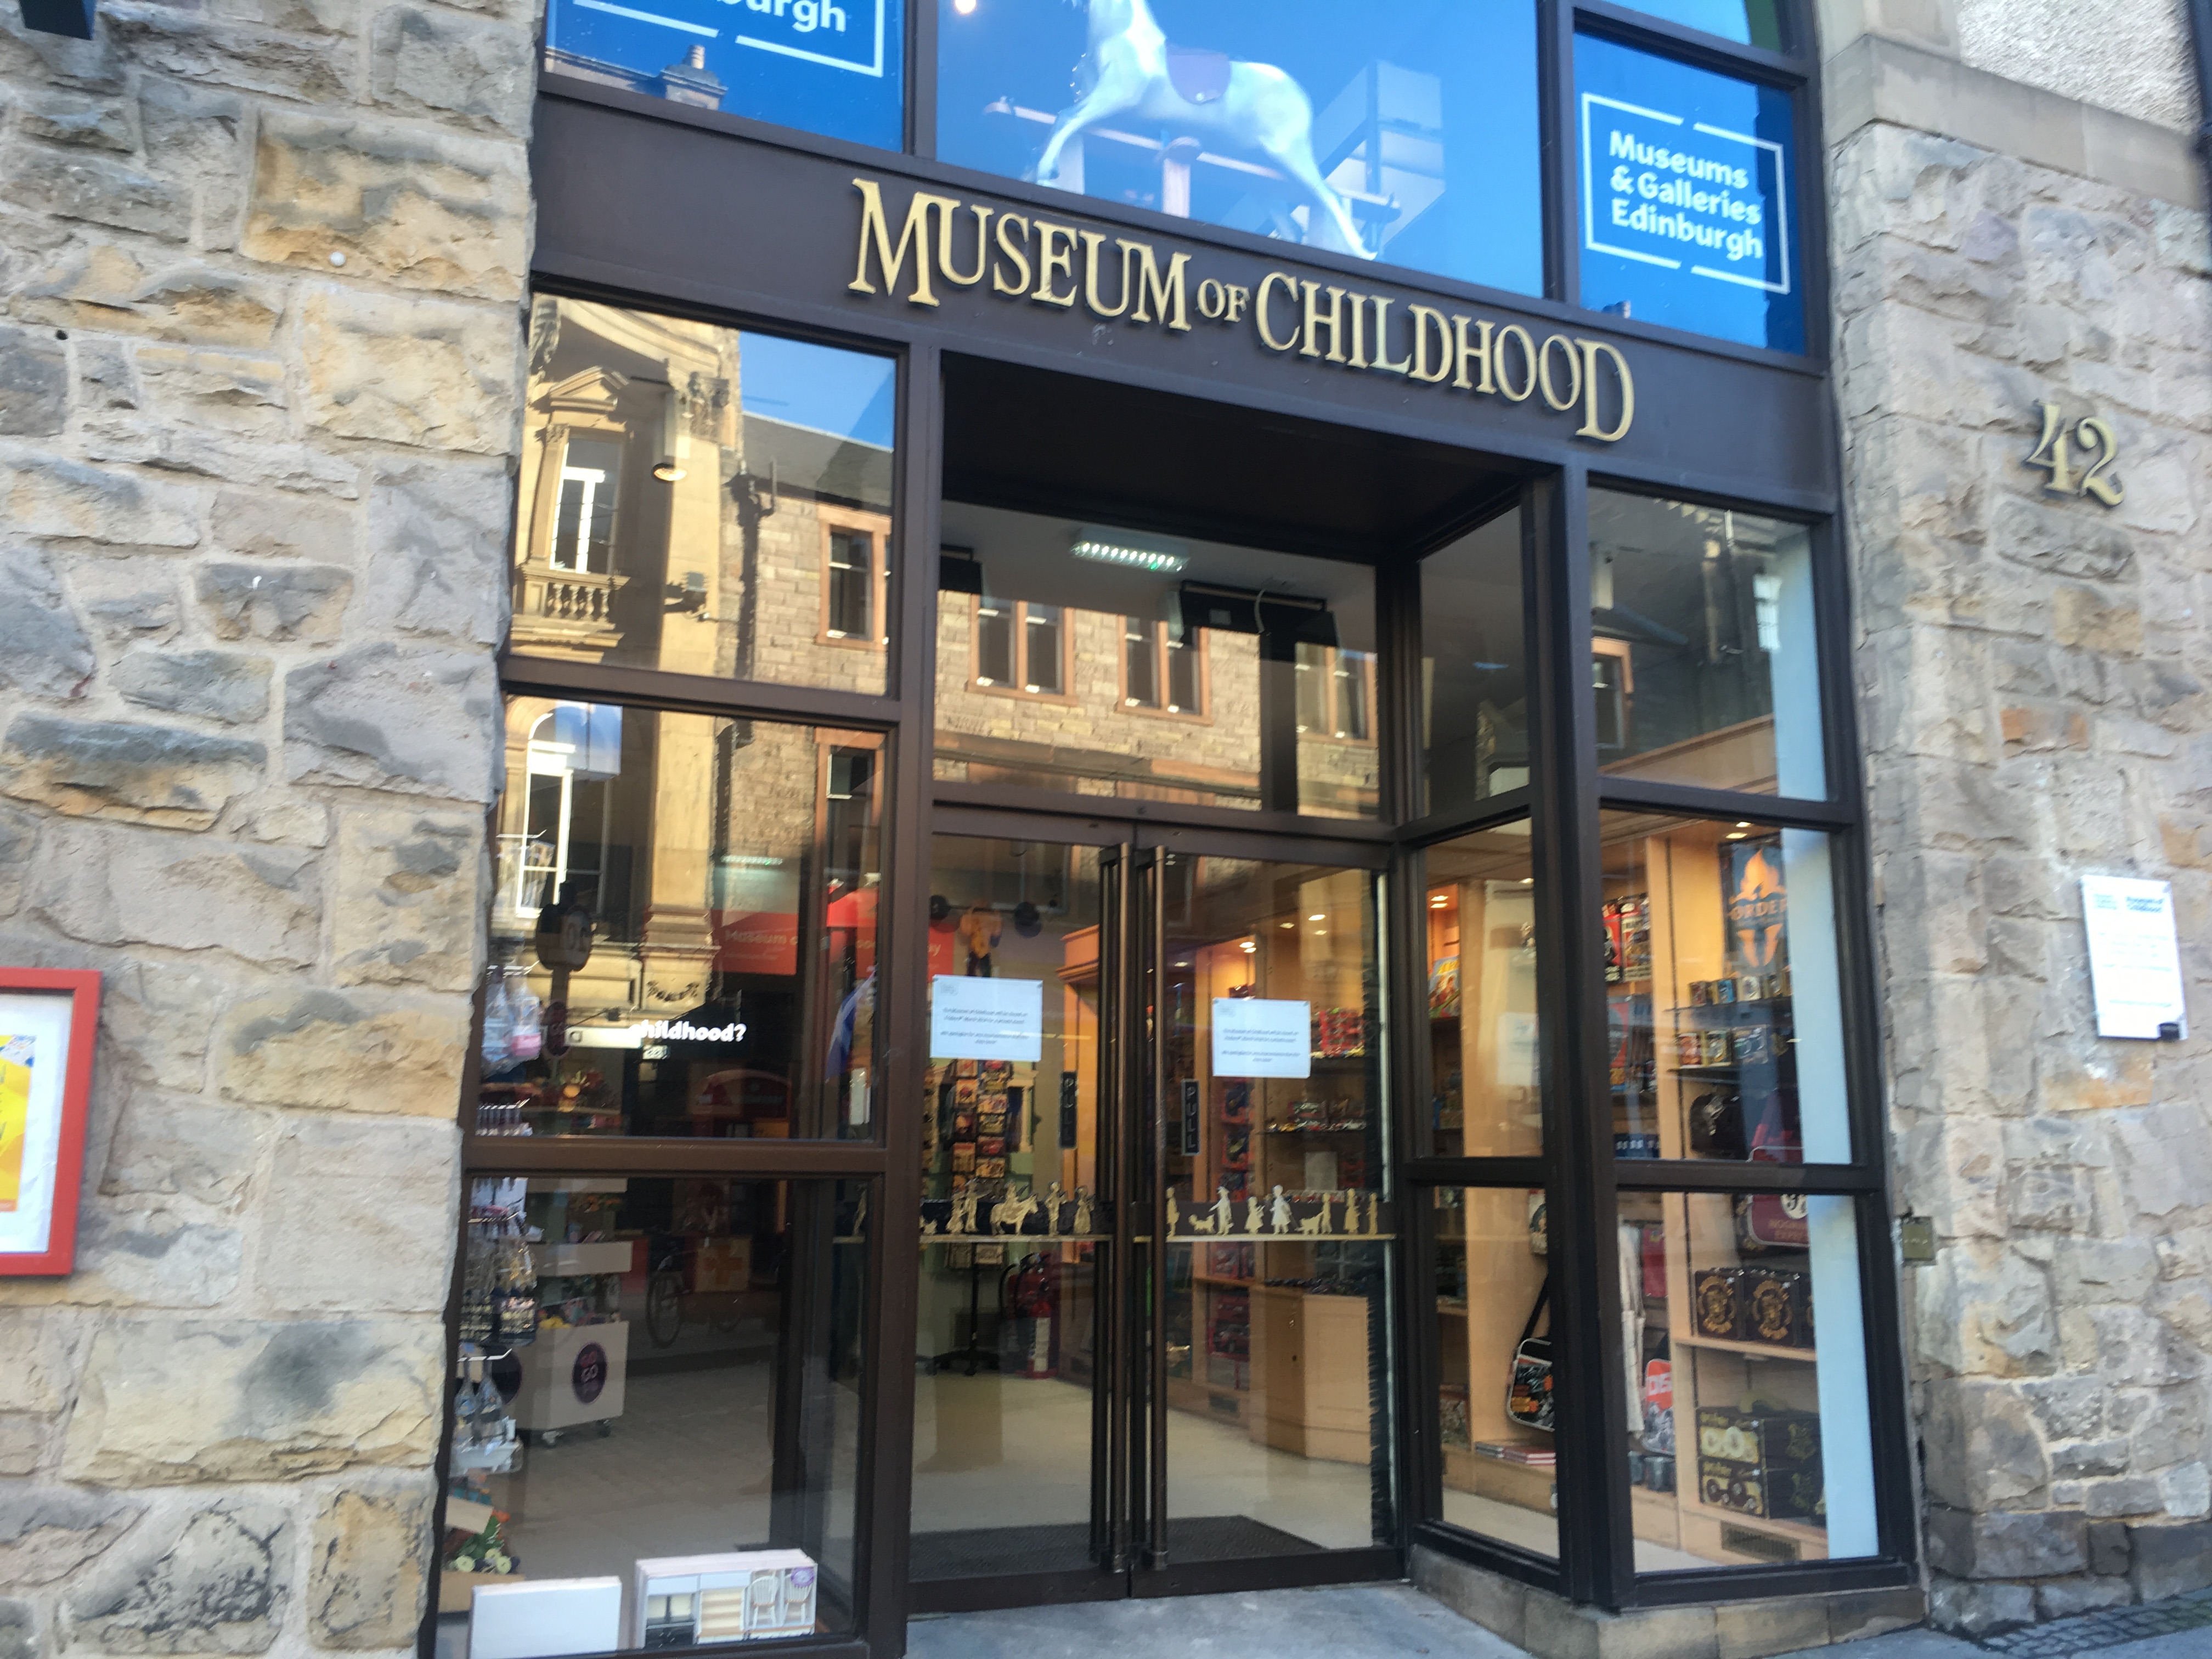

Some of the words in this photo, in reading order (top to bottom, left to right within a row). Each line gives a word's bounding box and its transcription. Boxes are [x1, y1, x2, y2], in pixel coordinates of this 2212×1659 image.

[1609, 129, 1749, 189] Museums
[1610, 165, 1635, 195] &
[1637, 172, 1762, 225] Galleries
[1611, 198, 1764, 261] Edinburgh
[848, 177, 1191, 330] MUSEUM
[1197, 279, 1248, 322] OF
[1255, 272, 1634, 441] CHILDHOOD
[2027, 402, 2125, 506] 42
[1186, 1086, 1197, 1149] PULL
